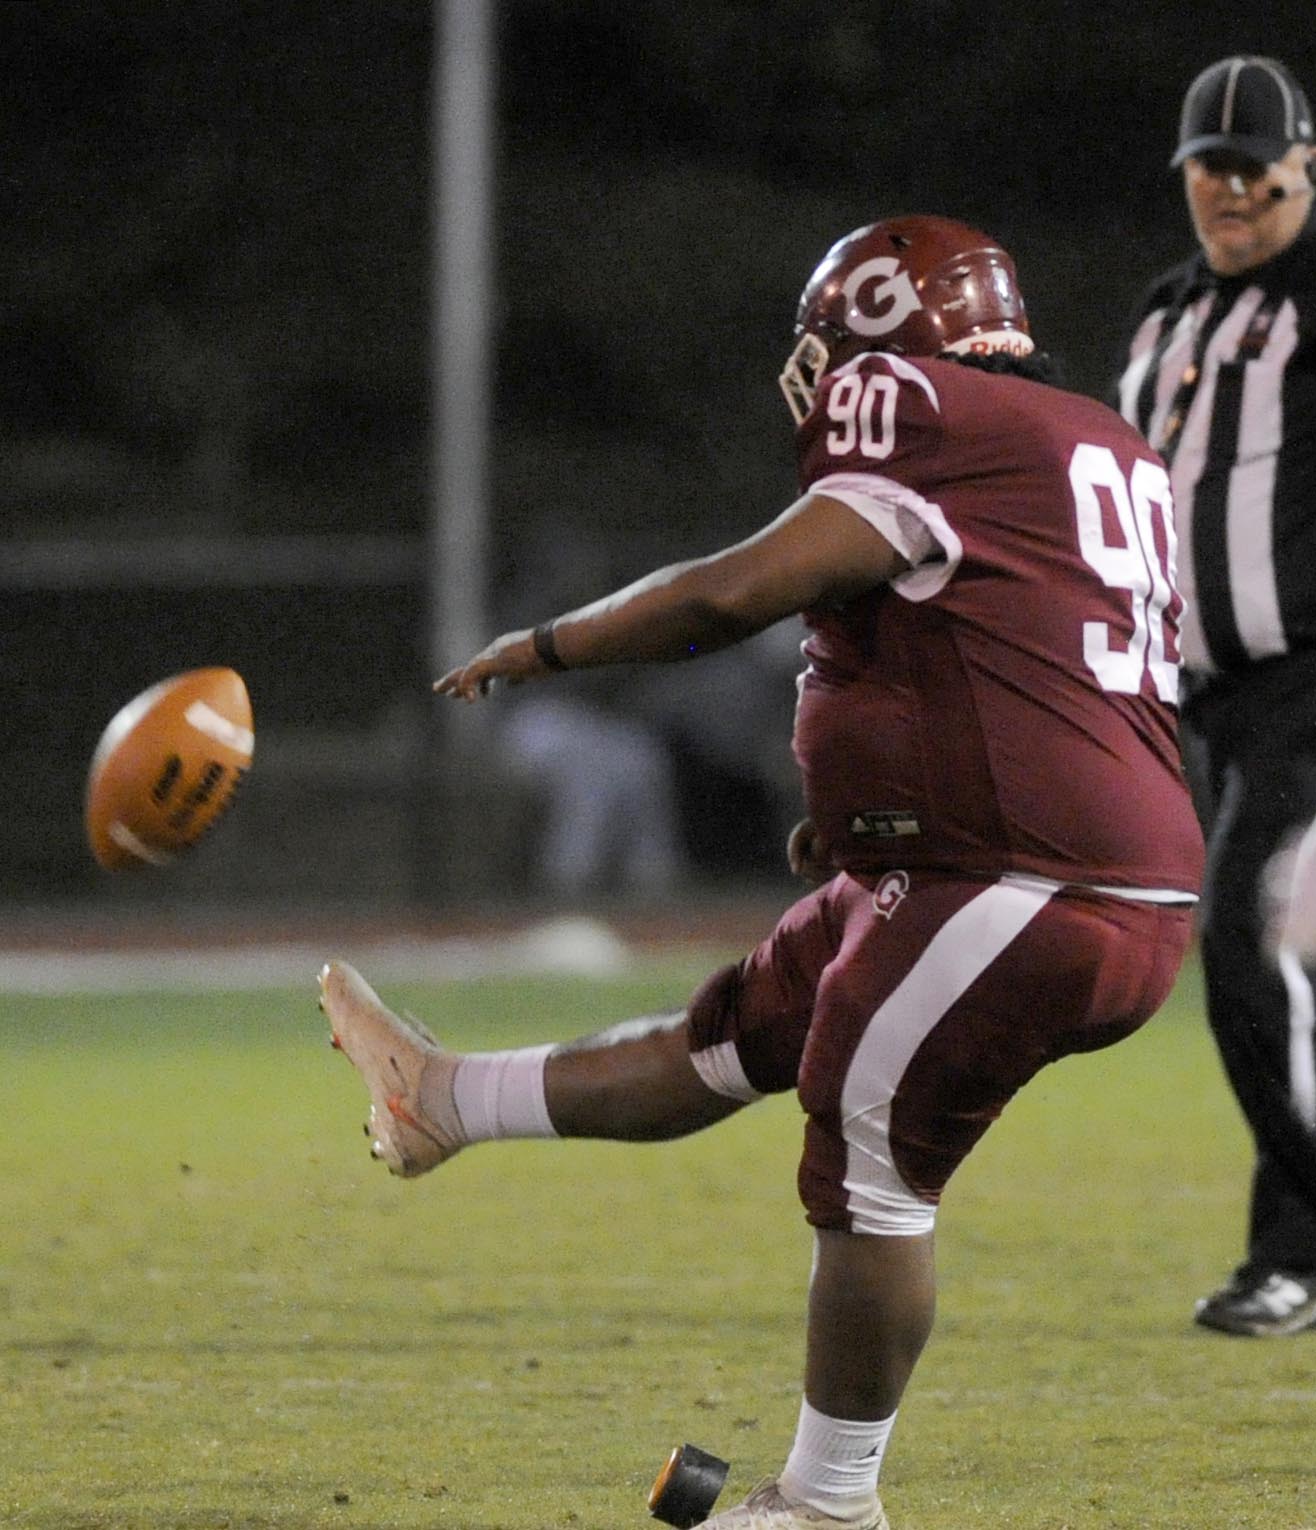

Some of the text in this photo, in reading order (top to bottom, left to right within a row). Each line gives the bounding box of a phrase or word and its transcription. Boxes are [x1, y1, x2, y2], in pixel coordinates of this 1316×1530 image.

[842, 257, 923, 336] G
[827, 374, 899, 460] 90
[1068, 443, 1188, 705] 90
